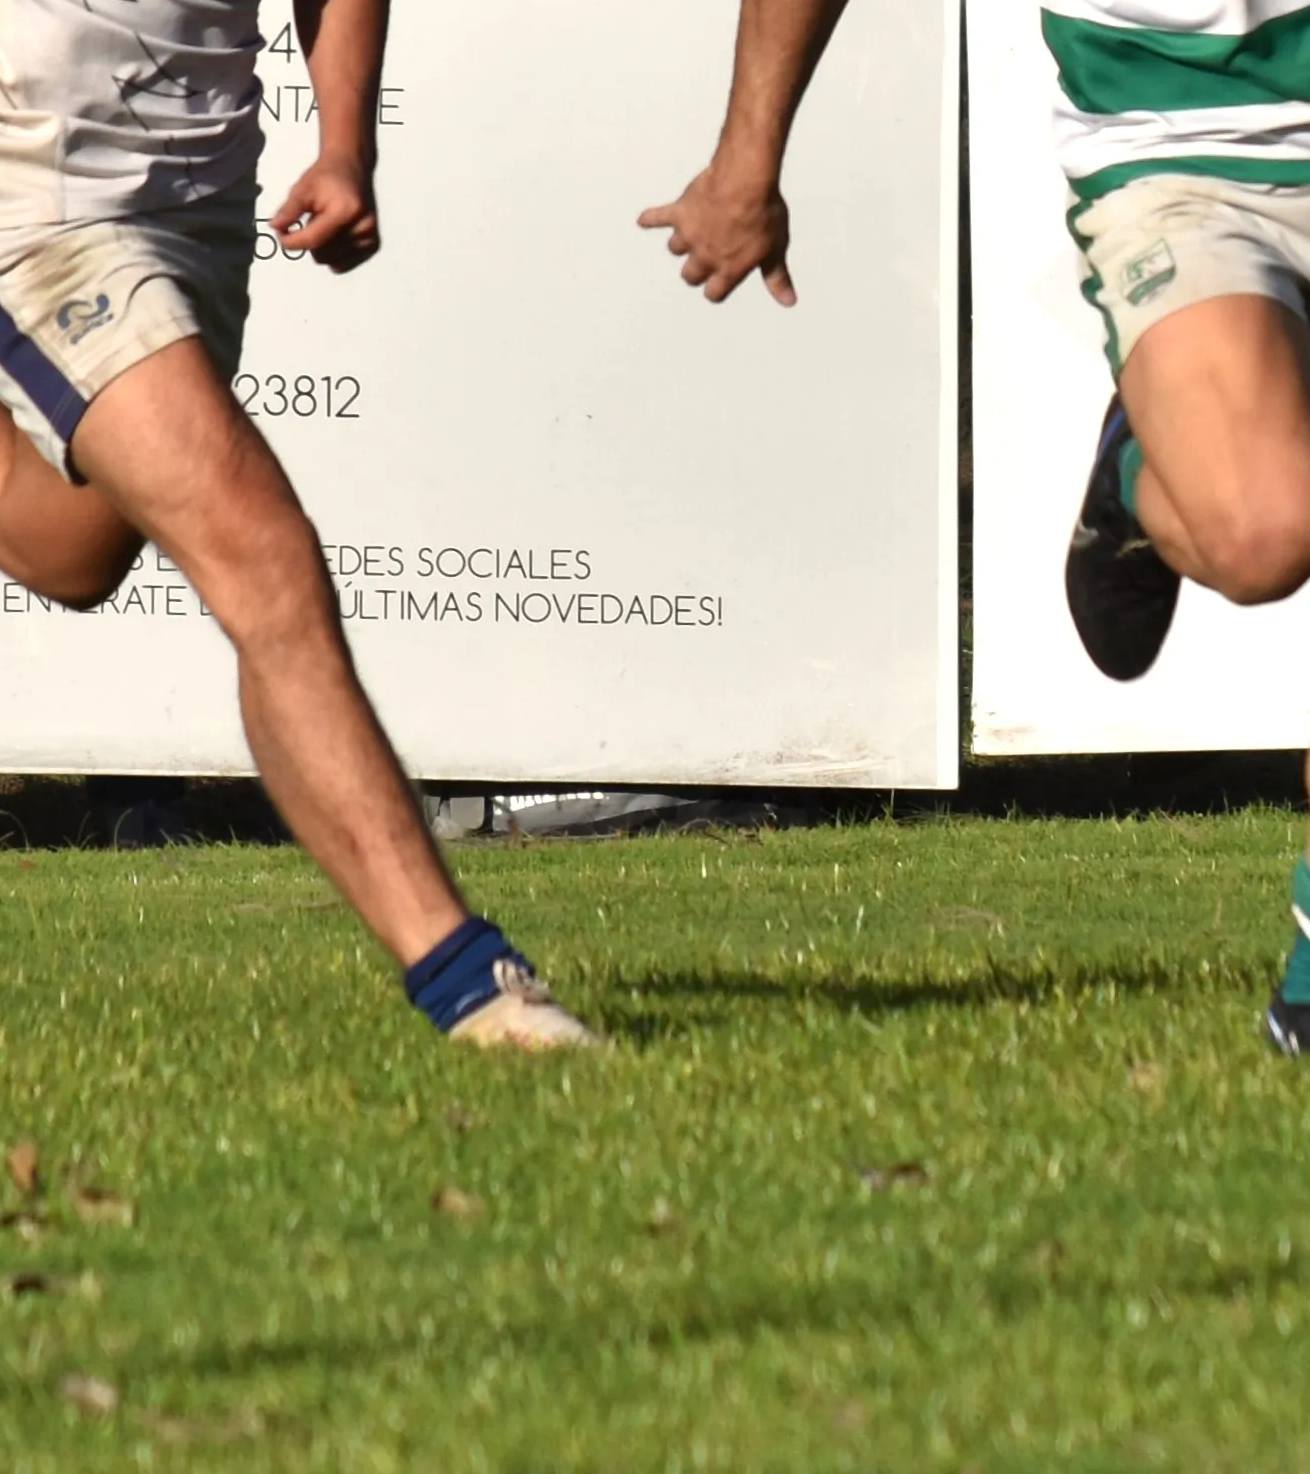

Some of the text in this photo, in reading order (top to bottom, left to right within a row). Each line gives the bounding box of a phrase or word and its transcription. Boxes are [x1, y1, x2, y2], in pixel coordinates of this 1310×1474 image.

[319, 544, 405, 578] EDES
[417, 546, 591, 581] SOCIALES
[494, 591, 724, 627] NOVEDADES!
